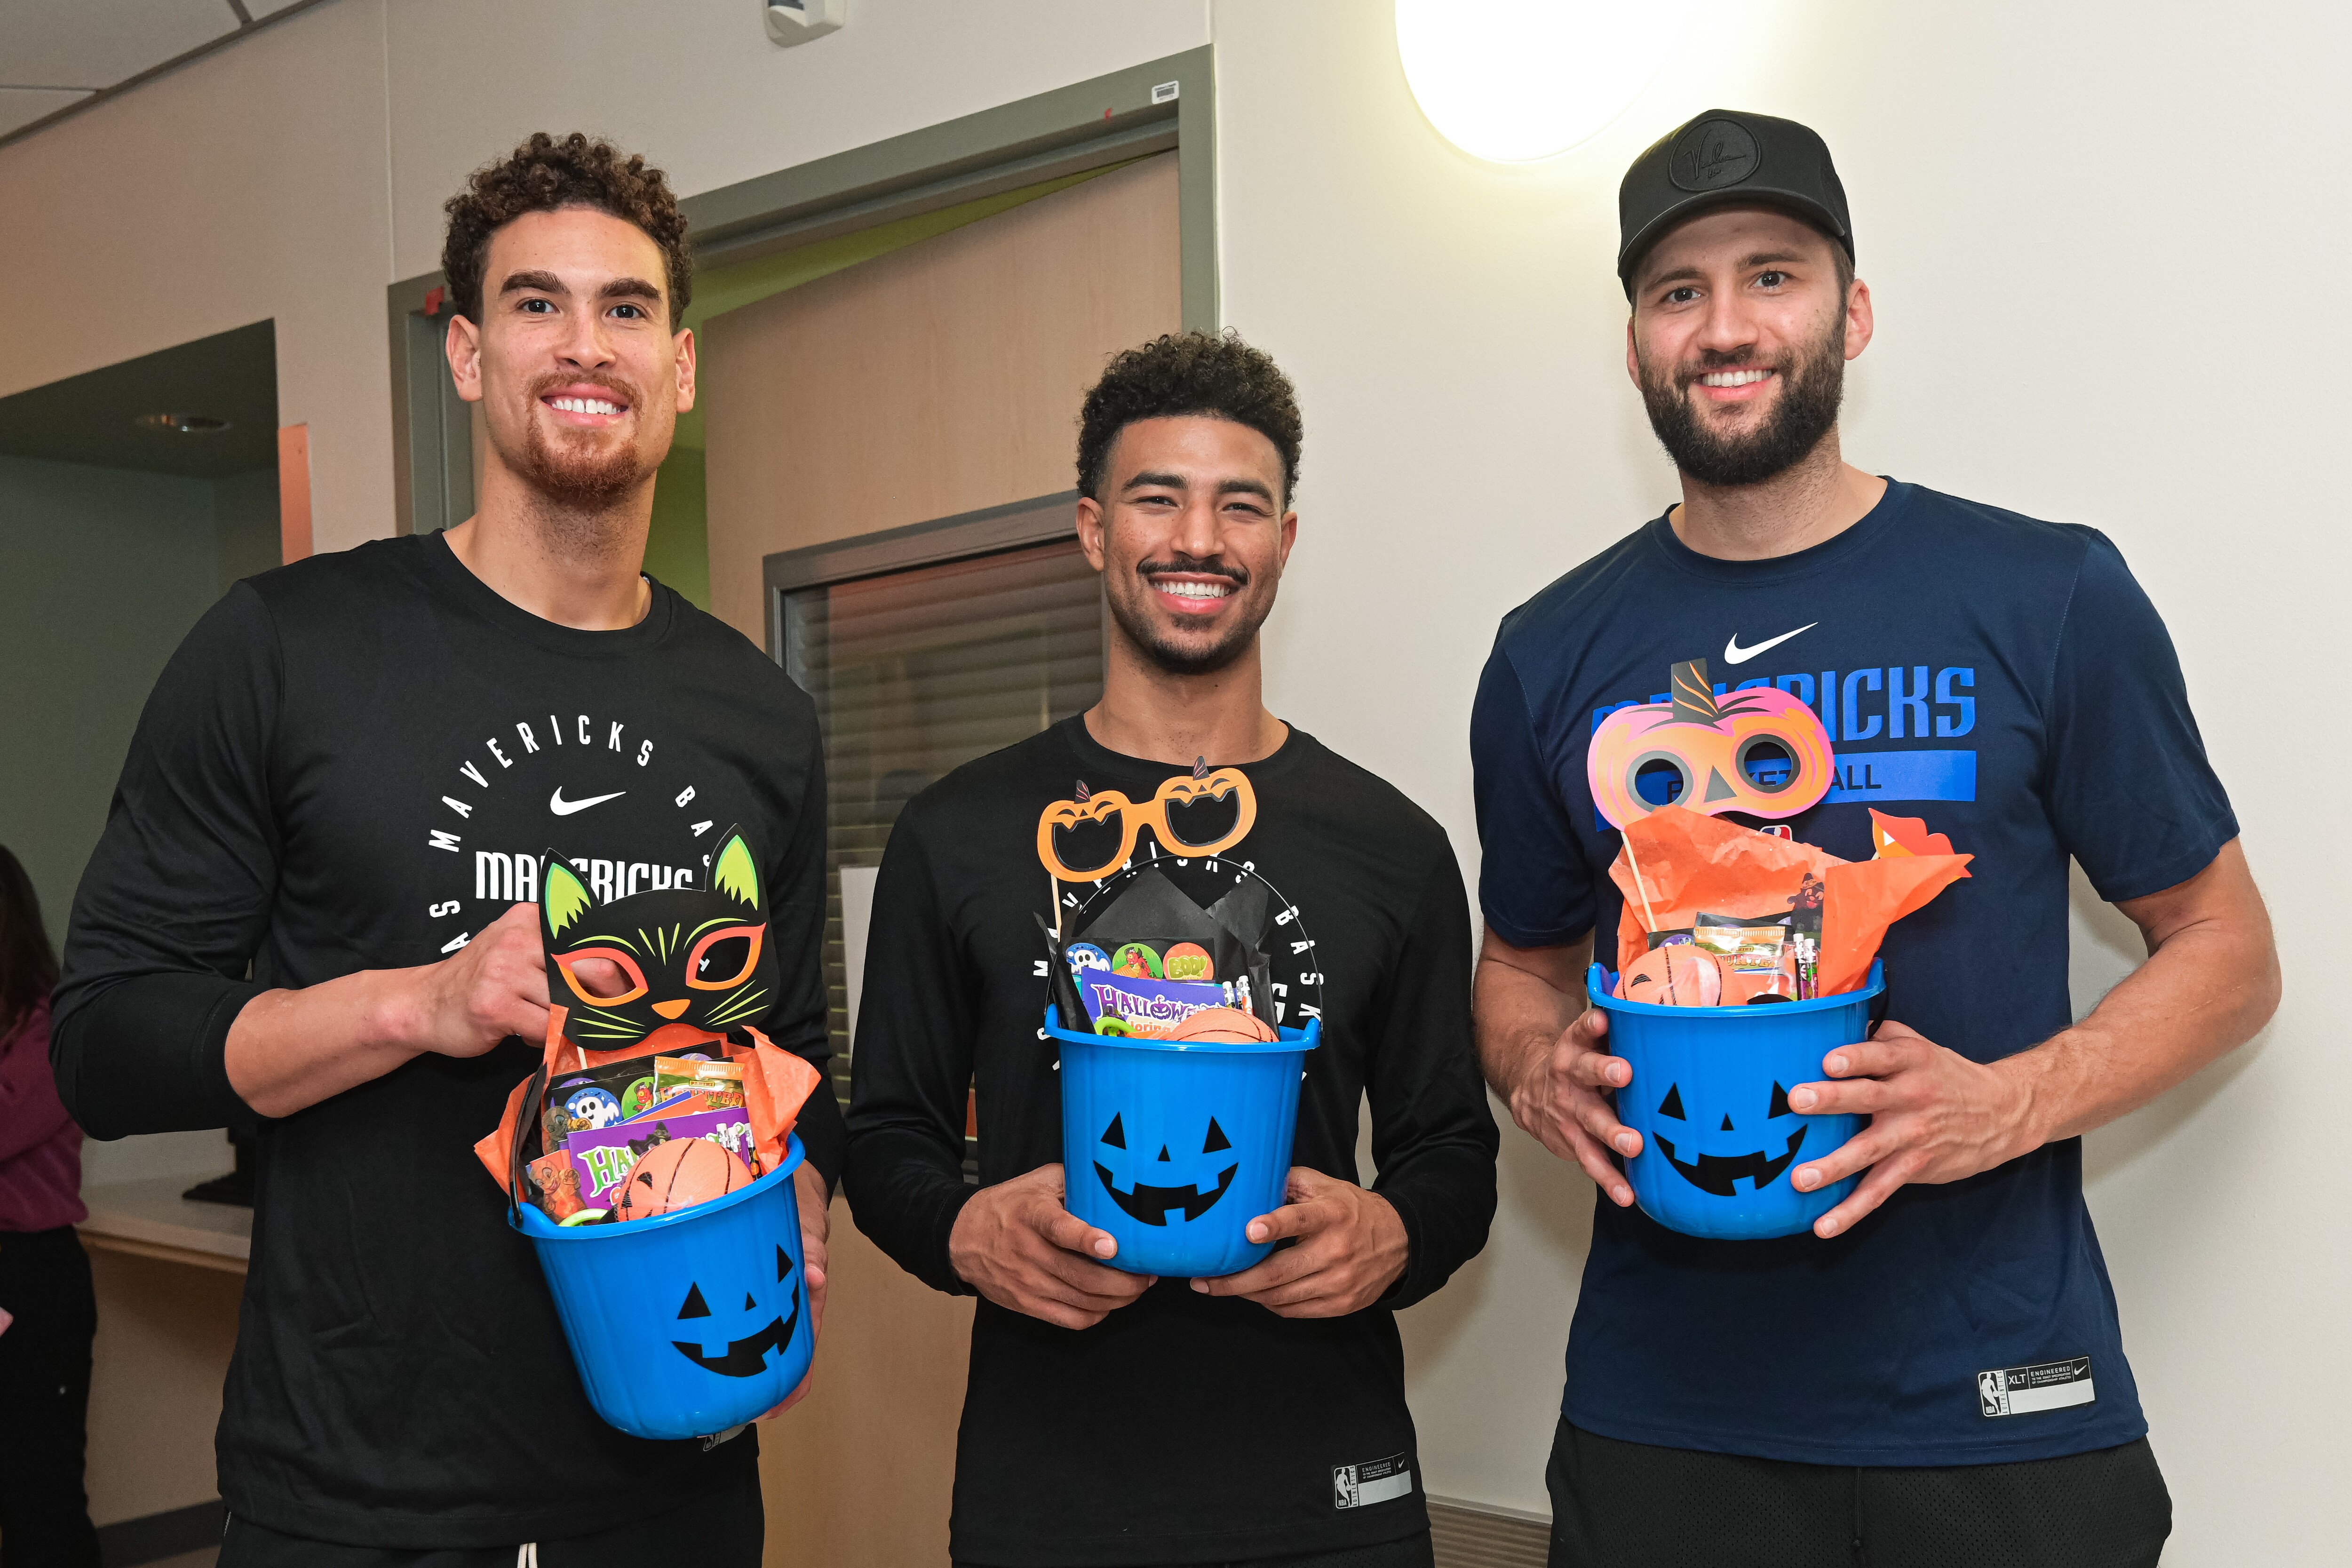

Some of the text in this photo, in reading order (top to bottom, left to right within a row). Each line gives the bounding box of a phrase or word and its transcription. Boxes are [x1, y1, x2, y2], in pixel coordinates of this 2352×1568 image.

[429, 715, 653, 852] MAVERICKS
[1167, 955, 1208, 979] BOO!
[2008, 1374, 2026, 1385] XLT
[2030, 1366, 2070, 1377] ENGINEERED
[1997, 1370, 2007, 1414] AUTHENTICS
[1362, 1462, 1391, 1472] ENGINEERED
